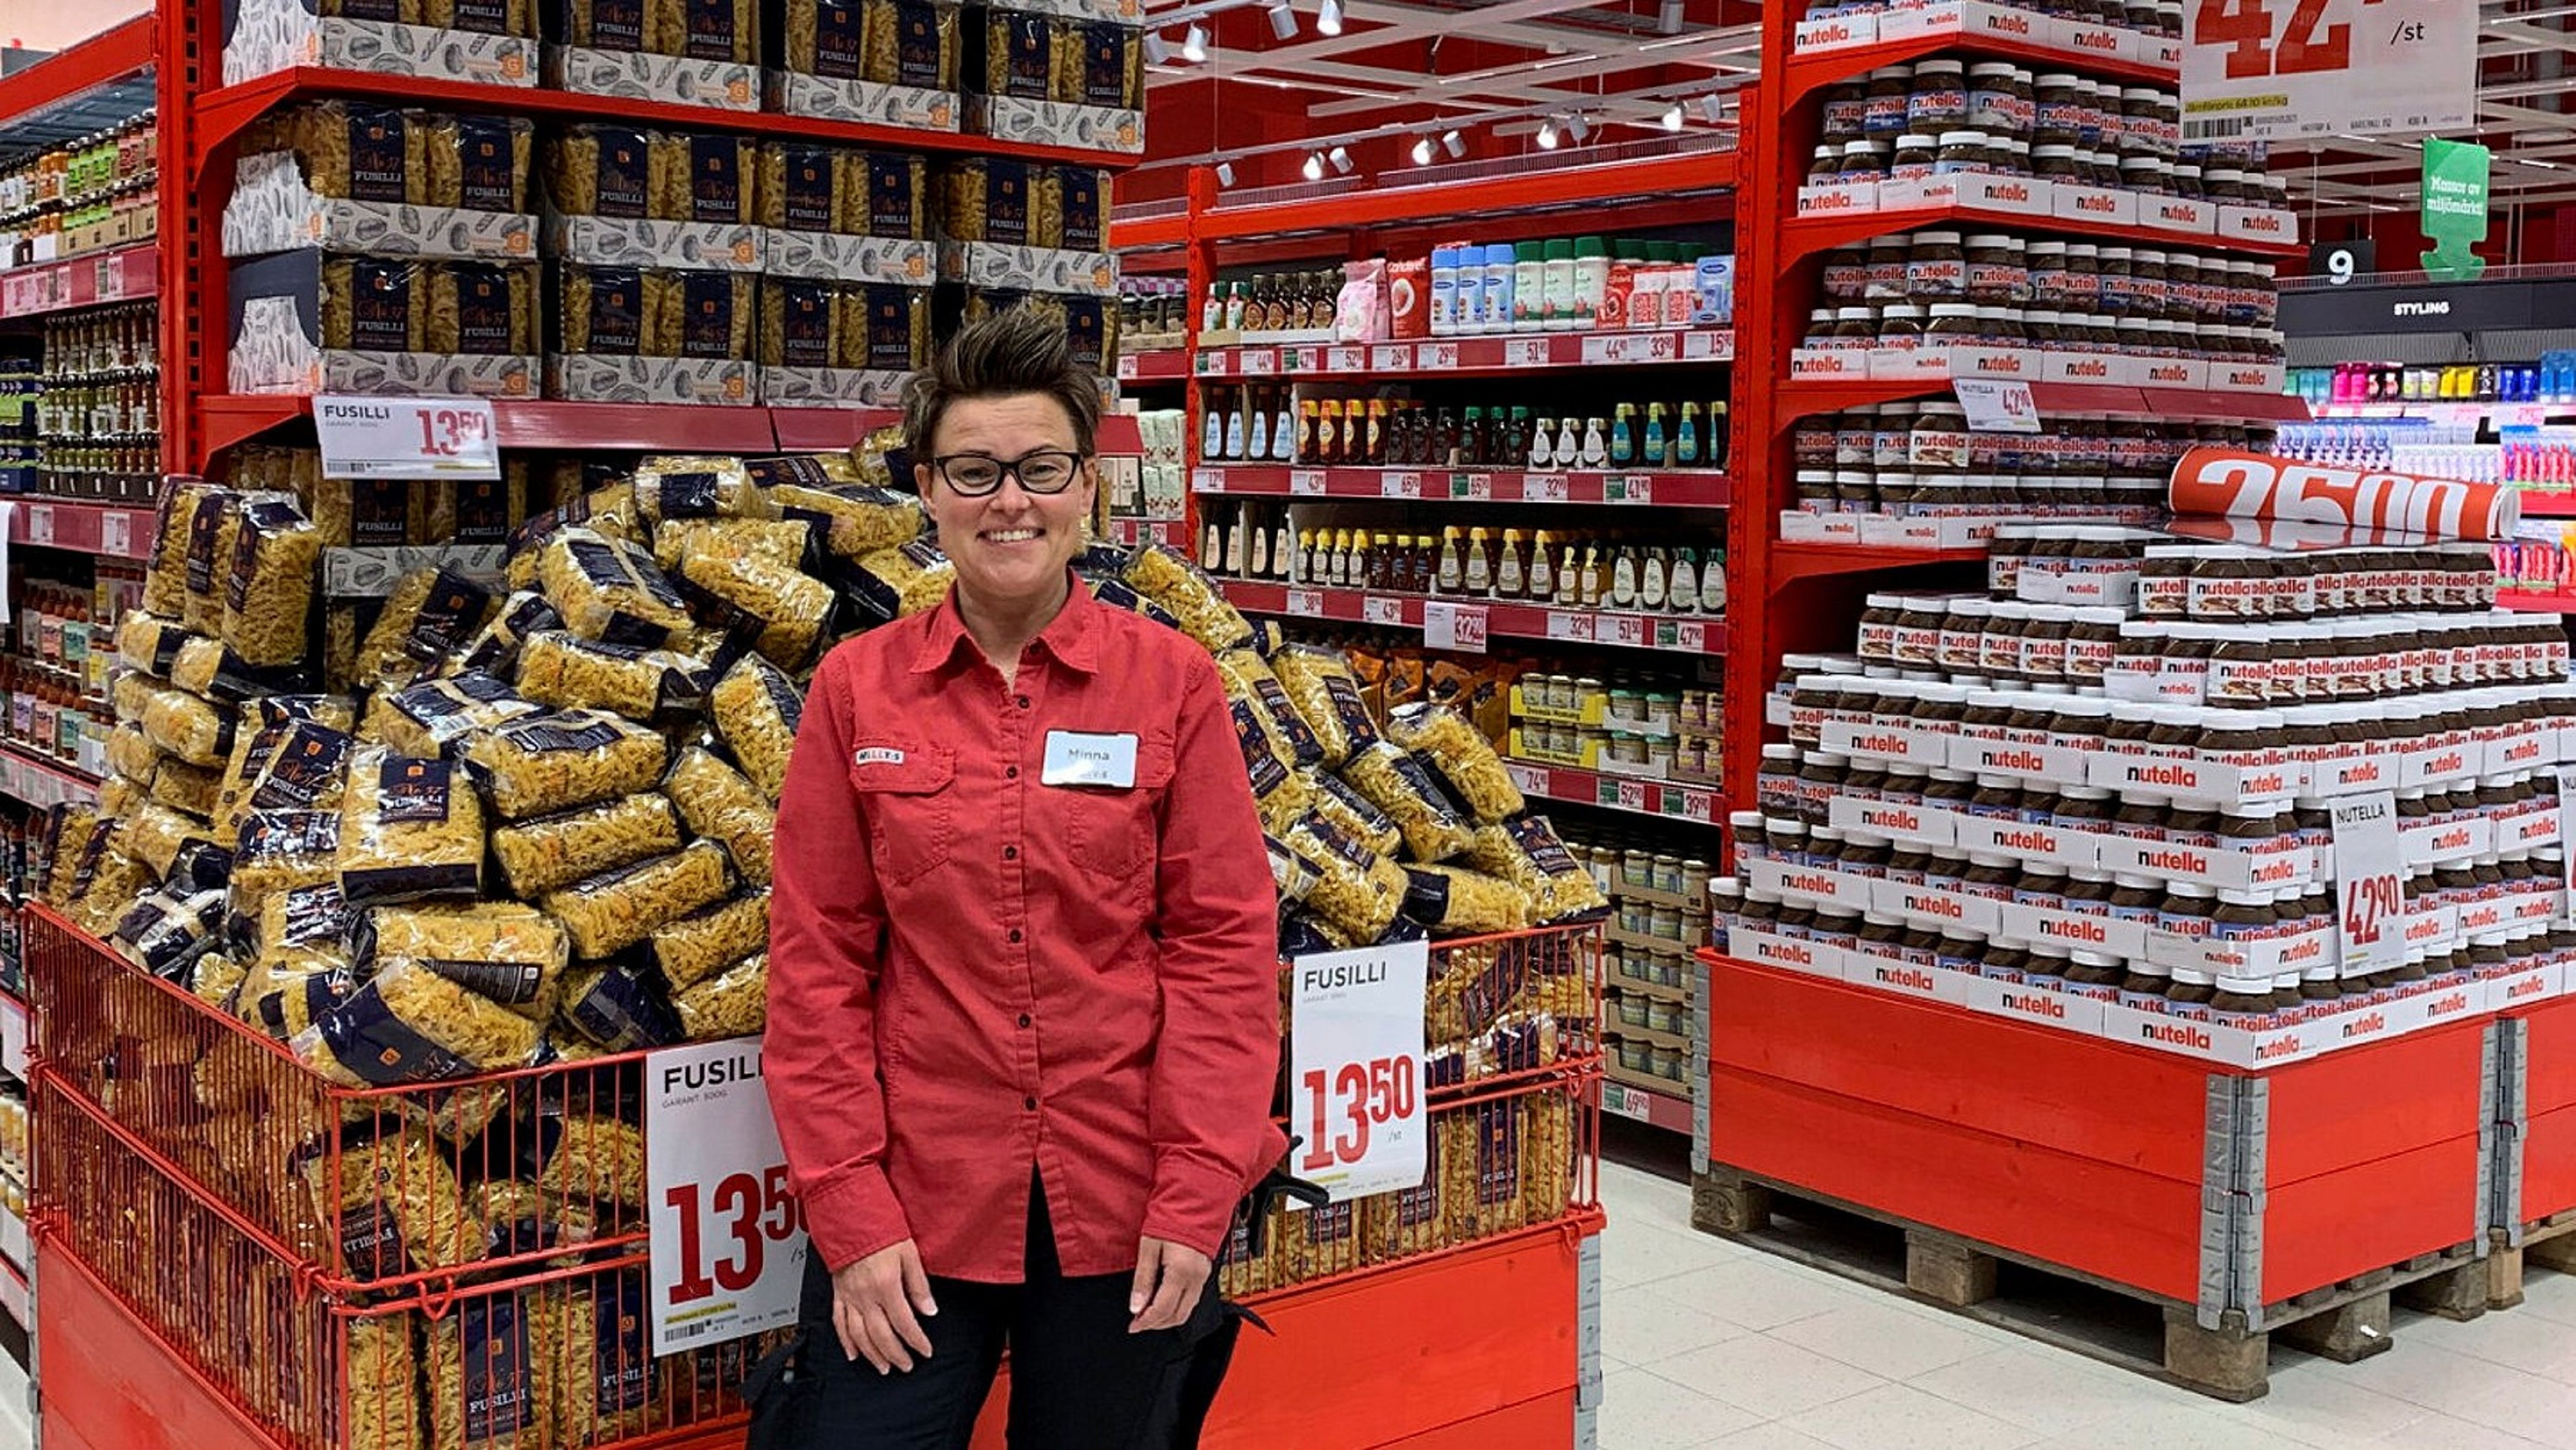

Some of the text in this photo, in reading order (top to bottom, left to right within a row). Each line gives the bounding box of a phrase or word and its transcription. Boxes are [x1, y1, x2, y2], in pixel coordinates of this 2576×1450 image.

[1988, 14, 2028, 35] nutella
[1797, 28, 1849, 45] nutella
[2075, 30, 2116, 49] nutella
[1865, 101, 1906, 112] nutell
[1912, 94, 1962, 107] nutella
[1800, 192, 1850, 211] nutella
[1985, 184, 2028, 202] nutella
[2077, 193, 2114, 213] nutella
[2160, 203, 2197, 223] nutella
[2242, 213, 2279, 232] nutella
[1826, 268, 1868, 282] nutell
[1909, 264, 1958, 278] nutella
[1974, 269, 2011, 284] nutel
[2328, 250, 2354, 284] 9
[2394, 303, 2449, 315] STYLING
[1793, 358, 1842, 374] nutella
[1978, 354, 2019, 373] nutella
[2066, 360, 2106, 377] nutella
[2150, 365, 2188, 382] nutella
[2229, 370, 2265, 385] nutella
[325, 406, 389, 419] FUSILLI
[1796, 434, 1837, 447] nutella
[1914, 433, 1965, 447] nutella
[2143, 581, 2188, 593] nutell
[2197, 581, 2250, 596] nutella
[1897, 631, 1938, 646] nutell
[1943, 635, 1979, 648] nutel
[2025, 642, 2065, 655] nutel
[2070, 643, 2113, 659] nutell
[2117, 659, 2161, 671] nutell
[2221, 666, 2270, 679] nutella
[2338, 659, 2379, 673] utella
[2158, 683, 2196, 694] nutella
[1852, 735, 1907, 754] nutella
[2504, 741, 2538, 762] nutella
[1069, 749, 1109, 760] Minna
[1982, 750, 2043, 771] nutella
[2424, 754, 2461, 774] nutella
[2126, 766, 2197, 787] nutella
[2340, 762, 2378, 784] nutella
[2241, 774, 2282, 794] nutella
[1862, 810, 1918, 830] nutella
[2337, 803, 2385, 823] NUTELLA
[2520, 818, 2556, 839] nutella
[1993, 831, 2056, 852] nutella
[2432, 831, 2470, 850] nutella
[2138, 851, 2206, 873] nutella
[2251, 862, 2293, 884] nutella
[1782, 873, 1835, 894] nutella
[1905, 896, 1962, 918] nutella
[2516, 898, 2553, 918] nutella
[2163, 920, 2211, 934] nutell
[2406, 919, 2439, 938] utella
[2461, 910, 2497, 929] nutella
[2040, 920, 2104, 942] nutella
[1759, 943, 1811, 964] nutella
[2279, 940, 2321, 964] nutella
[1304, 961, 1386, 991] FUSILLI
[1876, 966, 1933, 991] nutella
[2508, 977, 2543, 997] nutella
[2002, 992, 2064, 1018] nutella
[2428, 994, 2466, 1017] nutella
[2343, 1013, 2384, 1038] nutella
[2143, 1023, 2210, 1048] nutella
[2255, 1035, 2299, 1059] nutella
[664, 1054, 763, 1093] FUSIL
